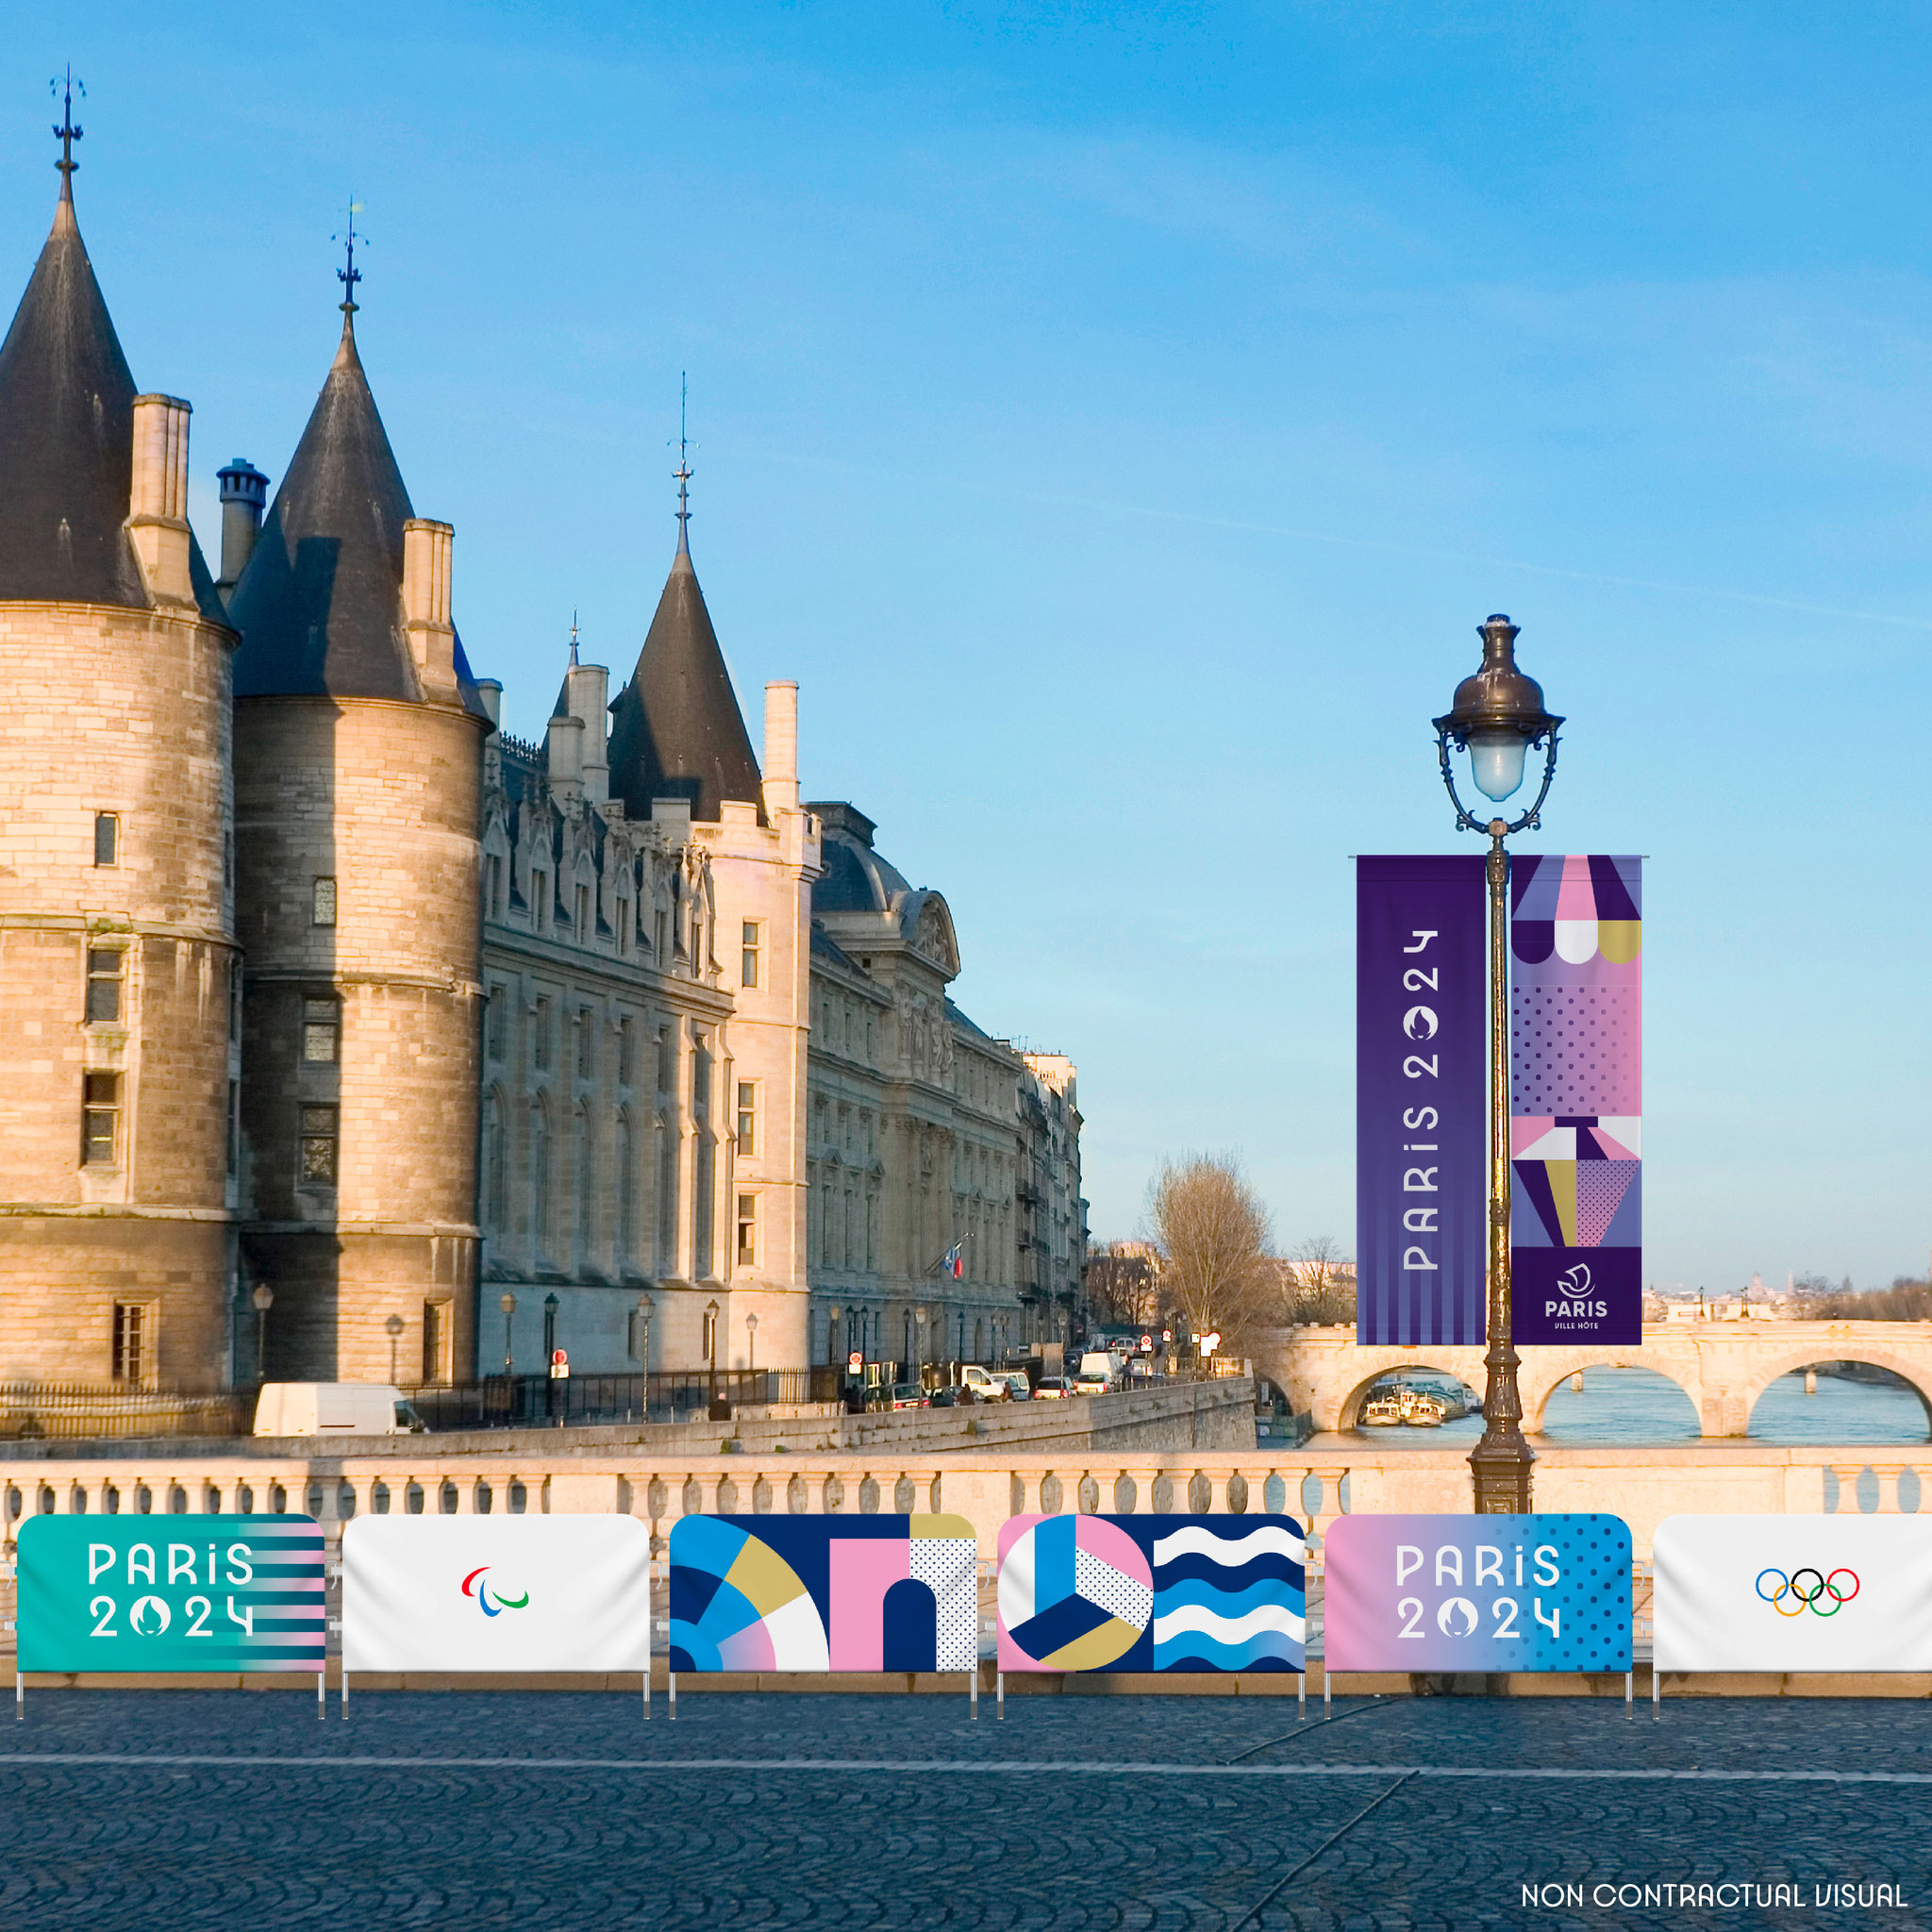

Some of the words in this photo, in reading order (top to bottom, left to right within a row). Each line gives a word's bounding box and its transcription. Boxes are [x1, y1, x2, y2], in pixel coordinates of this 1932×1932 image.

[1545, 1300, 1607, 1318] PARIS
[1555, 1322, 1575, 1330] VILLE
[1577, 1321, 1599, 1330] HÔTE
[90, 1595, 253, 1637] 2024
[1397, 1597, 1559, 1639] 2024
